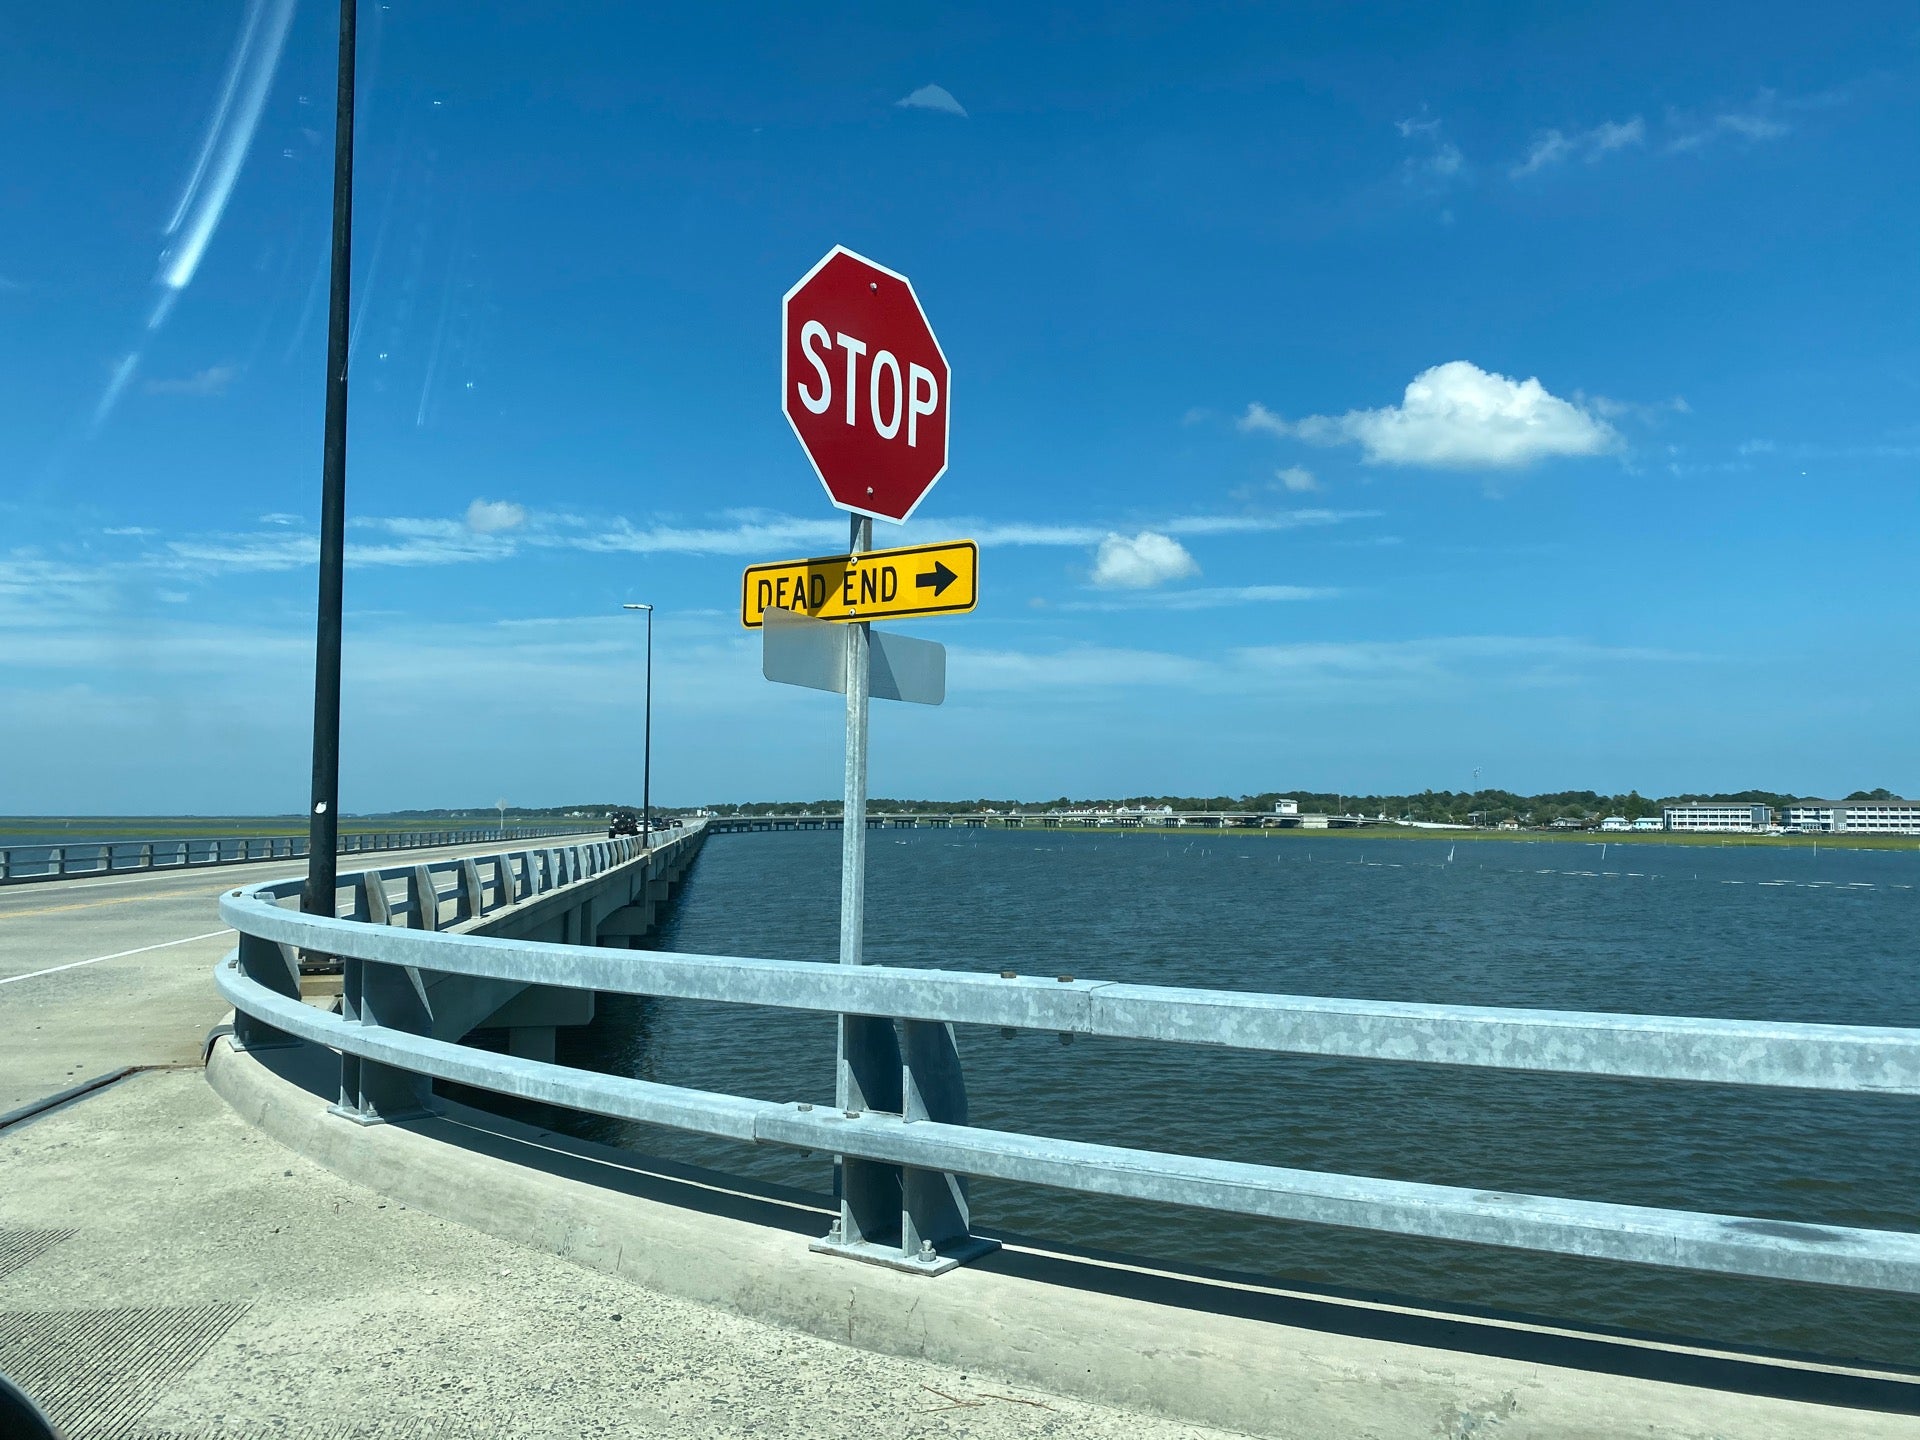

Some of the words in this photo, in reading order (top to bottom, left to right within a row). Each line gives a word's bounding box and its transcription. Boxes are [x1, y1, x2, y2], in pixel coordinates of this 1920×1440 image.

[797, 320, 939, 448] STOP
[757, 573, 826, 613] DEAD
[843, 566, 898, 606] END
